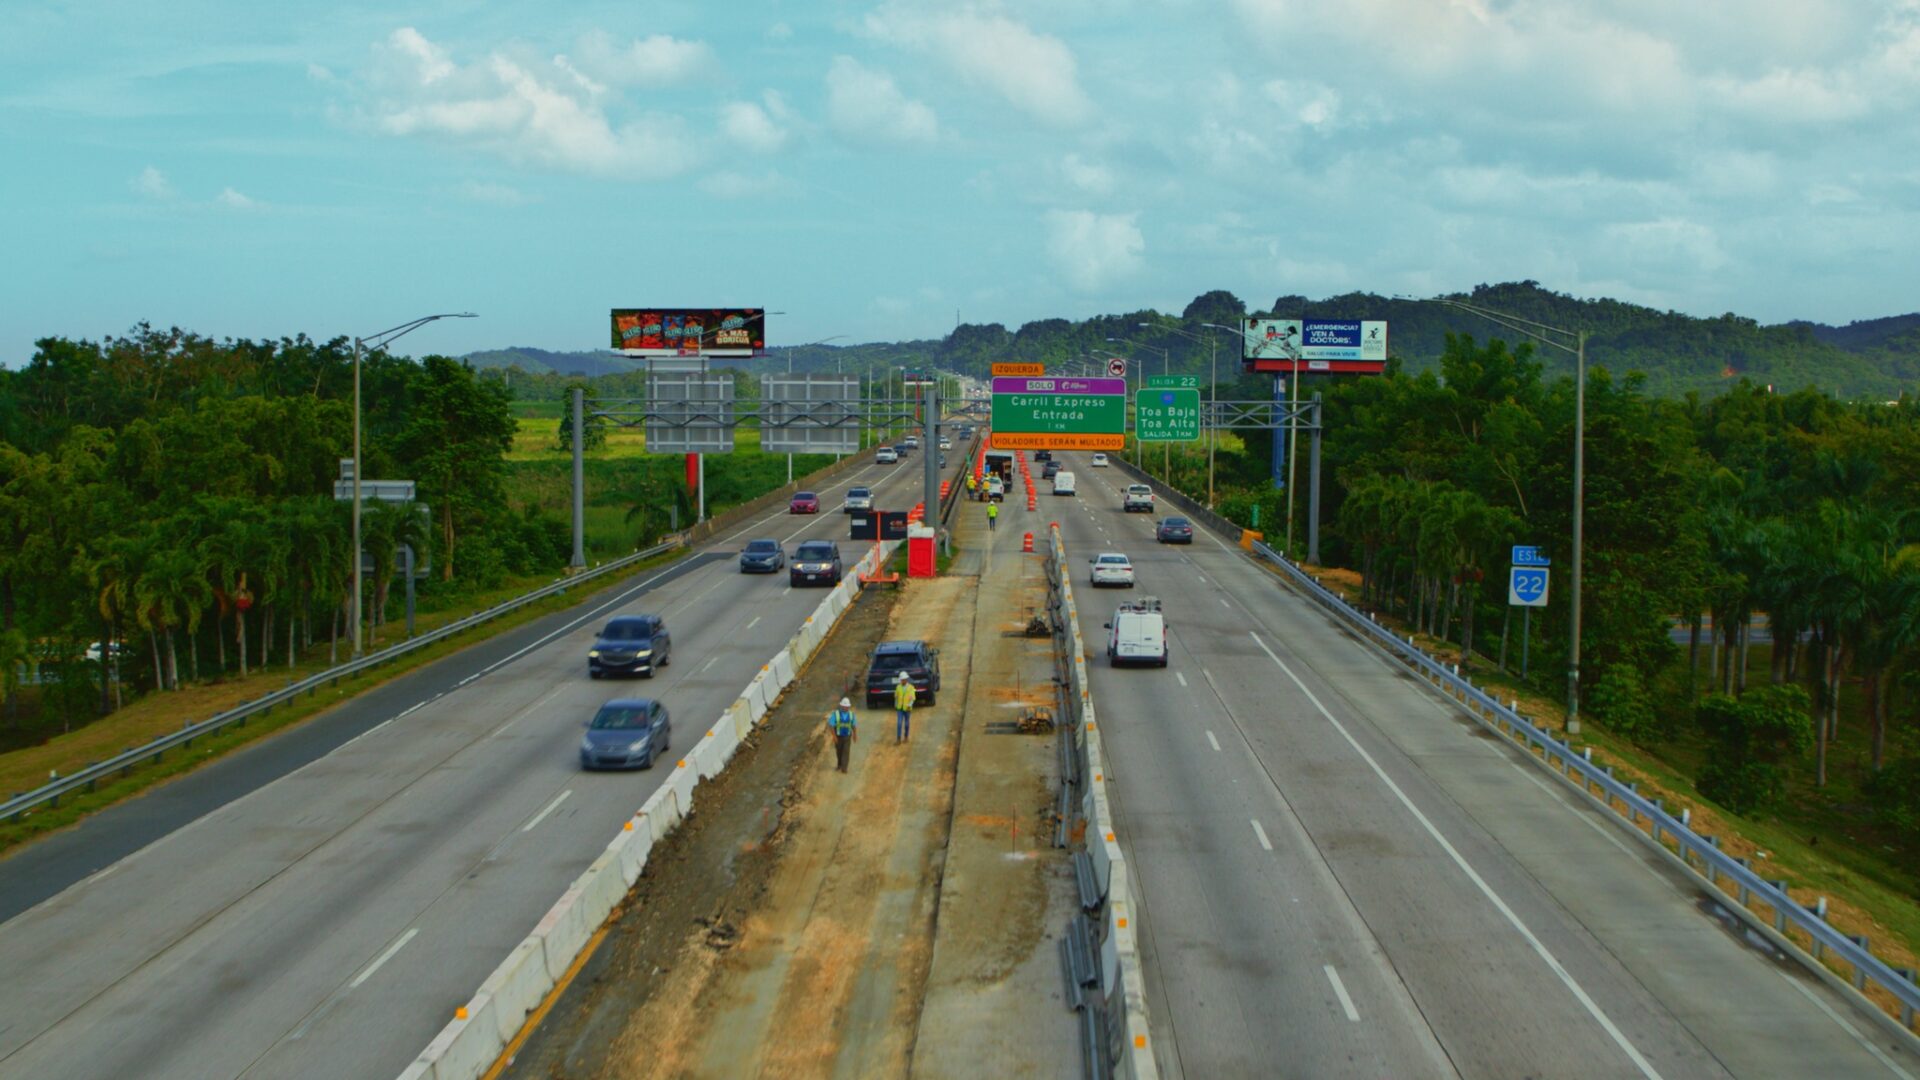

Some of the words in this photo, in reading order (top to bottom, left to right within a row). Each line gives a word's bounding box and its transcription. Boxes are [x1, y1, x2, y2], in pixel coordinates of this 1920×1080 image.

[716, 336, 750, 344] BORICUA
[995, 365, 1039, 373] IZQUIERDA
[1181, 377, 1196, 386] 22
[1011, 396, 1048, 406] Carril
[1054, 397, 1106, 408] Expreso
[1033, 410, 1084, 420] Entrada
[1140, 407, 1161, 416] Toa
[1168, 407, 1196, 418] Baja
[1140, 419, 1162, 428] Toa
[1169, 419, 1195, 428] Alta
[994, 438, 1044, 446] VIOLADORES
[1049, 437, 1076, 446] SERÁN
[1516, 576, 1542, 593] 22
